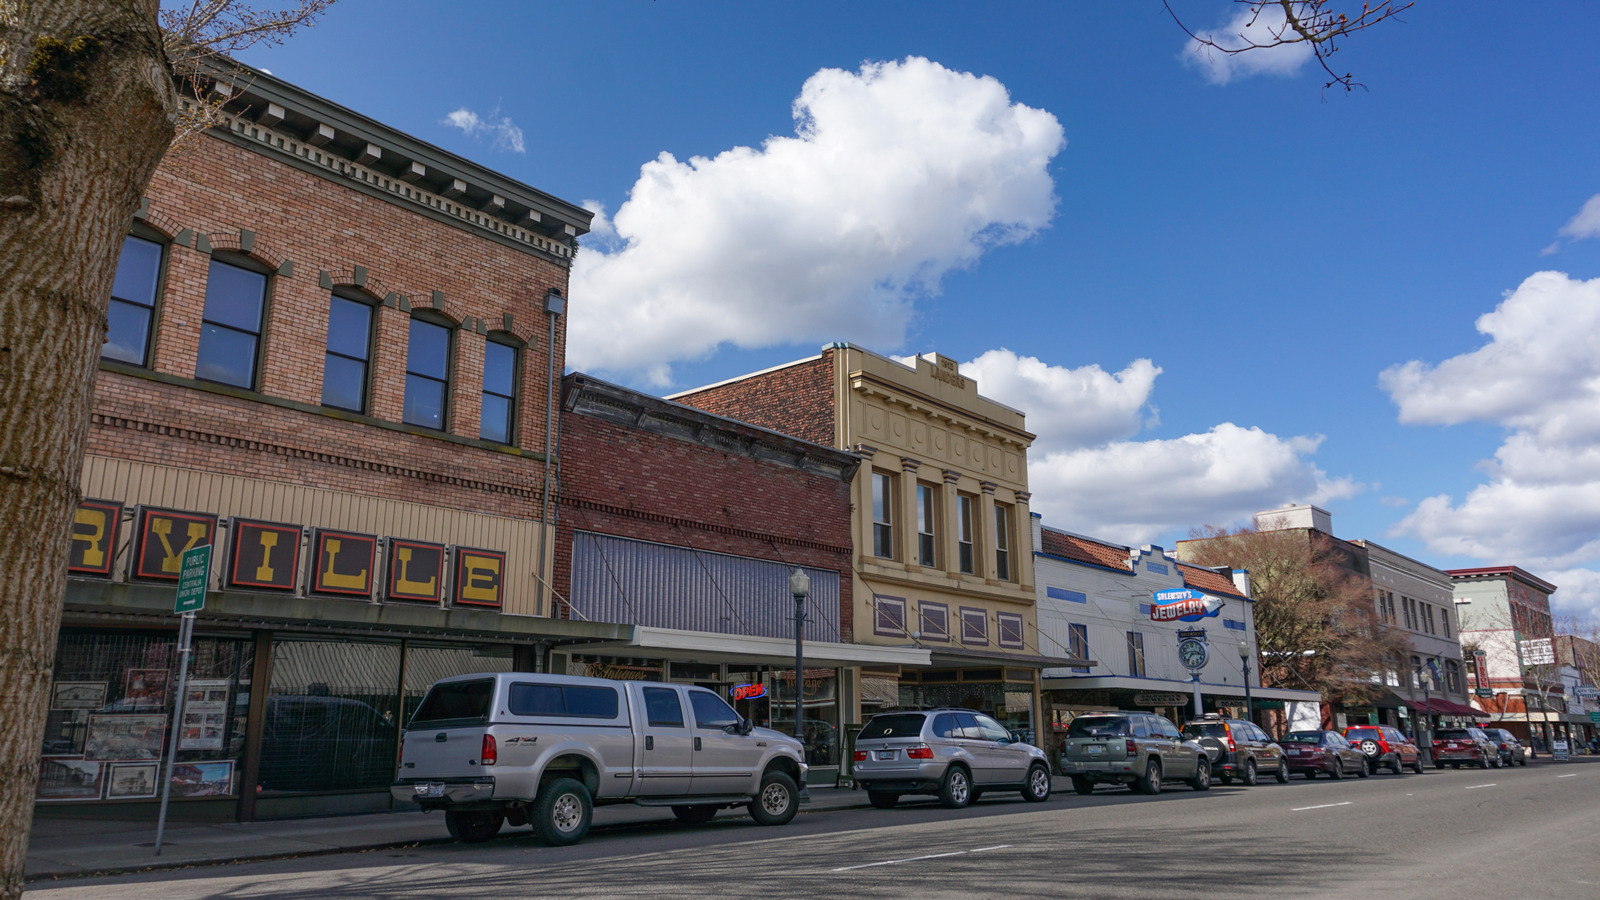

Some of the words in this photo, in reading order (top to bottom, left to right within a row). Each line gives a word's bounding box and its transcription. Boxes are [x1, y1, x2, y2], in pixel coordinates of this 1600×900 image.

[186, 554, 205, 567] PUBLIC
[183, 566, 205, 579] PARKING
[183, 579, 202, 589] CENTRALIA
[191, 587, 203, 596] DEPOT
[1156, 590, 1193, 601] SALEWSKY'S
[1152, 601, 1203, 620] JEWELRY
[1477, 656, 1488, 688] GIBSON
[735, 683, 764, 701] OPEN
